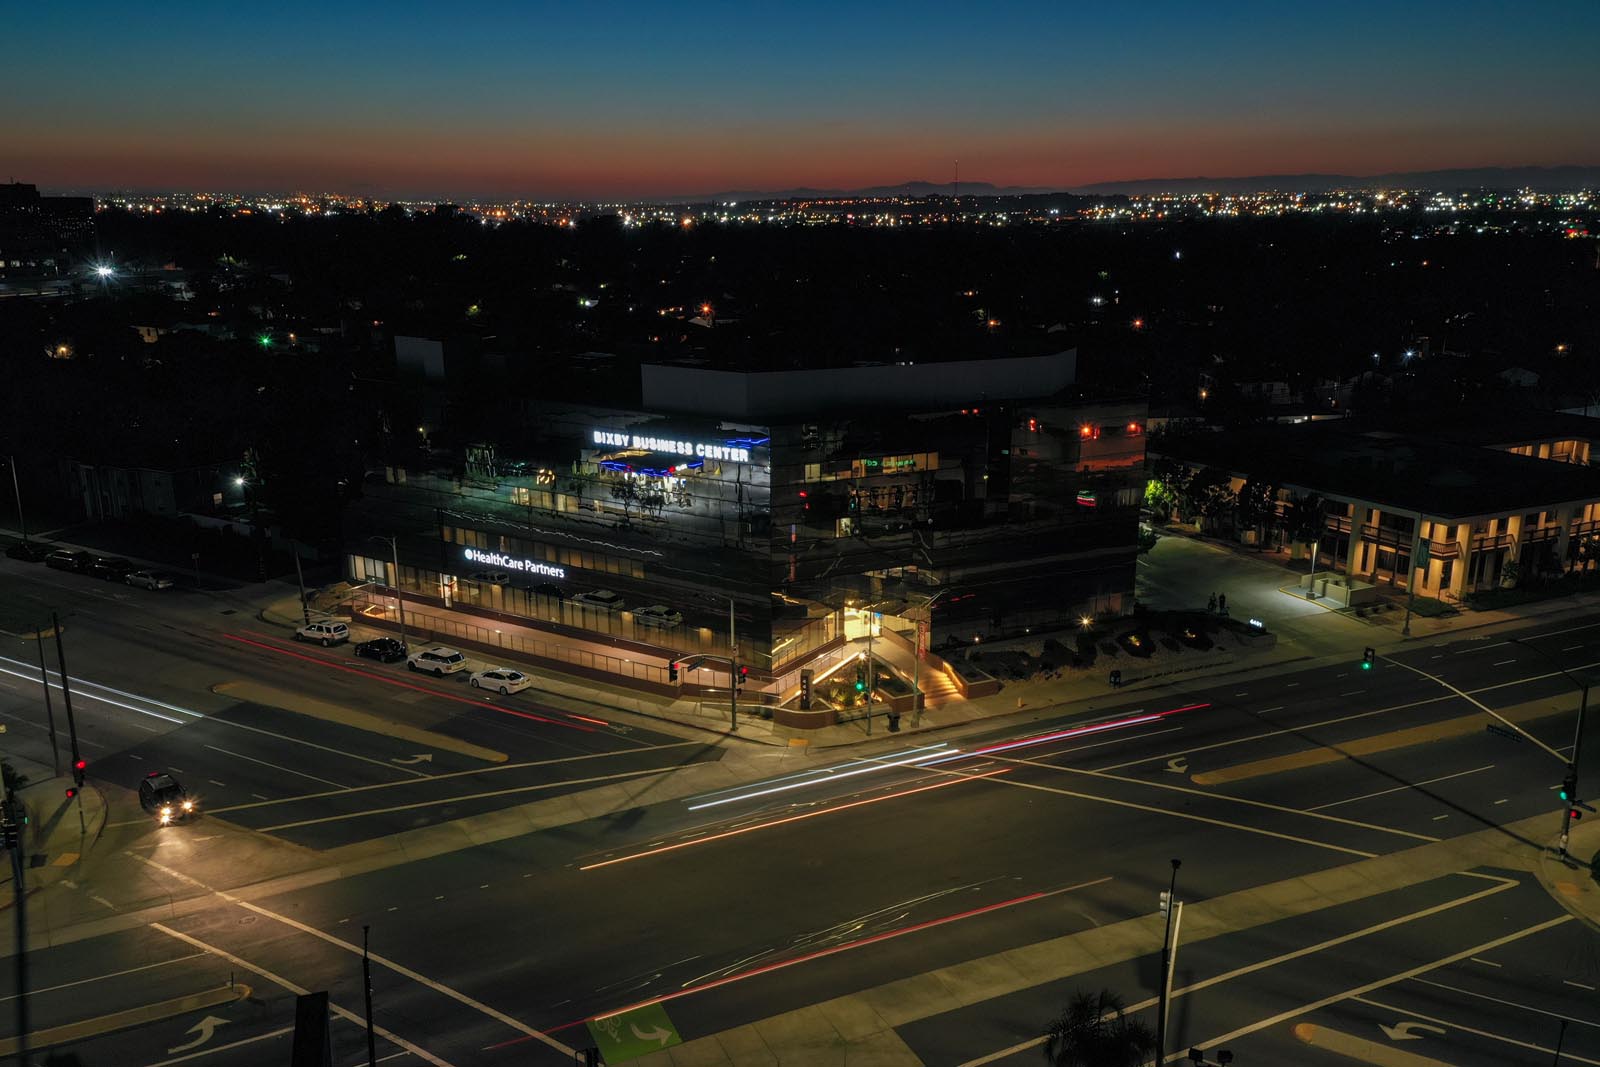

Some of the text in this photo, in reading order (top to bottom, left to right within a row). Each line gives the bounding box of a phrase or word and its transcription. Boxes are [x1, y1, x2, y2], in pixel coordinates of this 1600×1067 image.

[593, 430, 749, 463] BIXBY BUSINESS CENTER
[473, 549, 565, 578] HealthCare Partners
